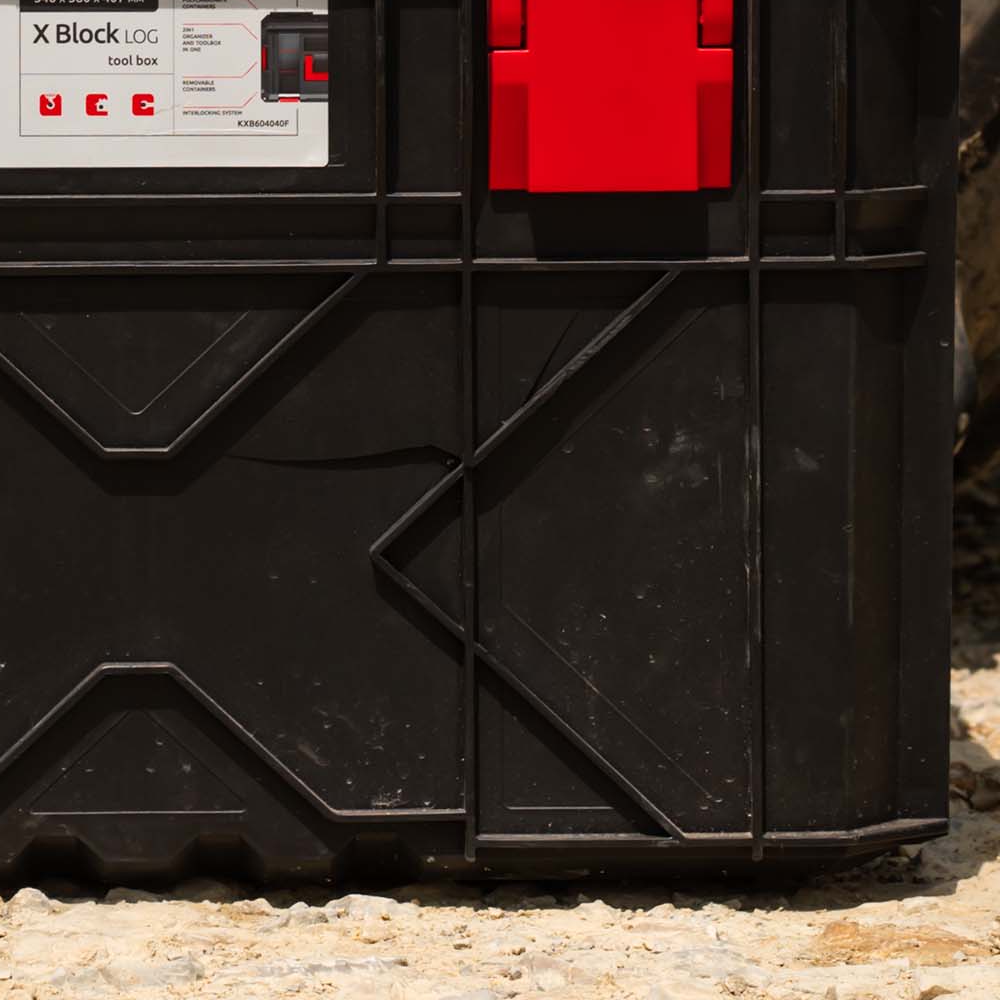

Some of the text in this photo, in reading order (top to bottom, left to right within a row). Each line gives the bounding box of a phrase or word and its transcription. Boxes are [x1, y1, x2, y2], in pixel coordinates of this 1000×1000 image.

[32, 21, 159, 44] X Block LOG
[108, 54, 159, 66] tool box
[237, 119, 290, 128] KXB604040F
